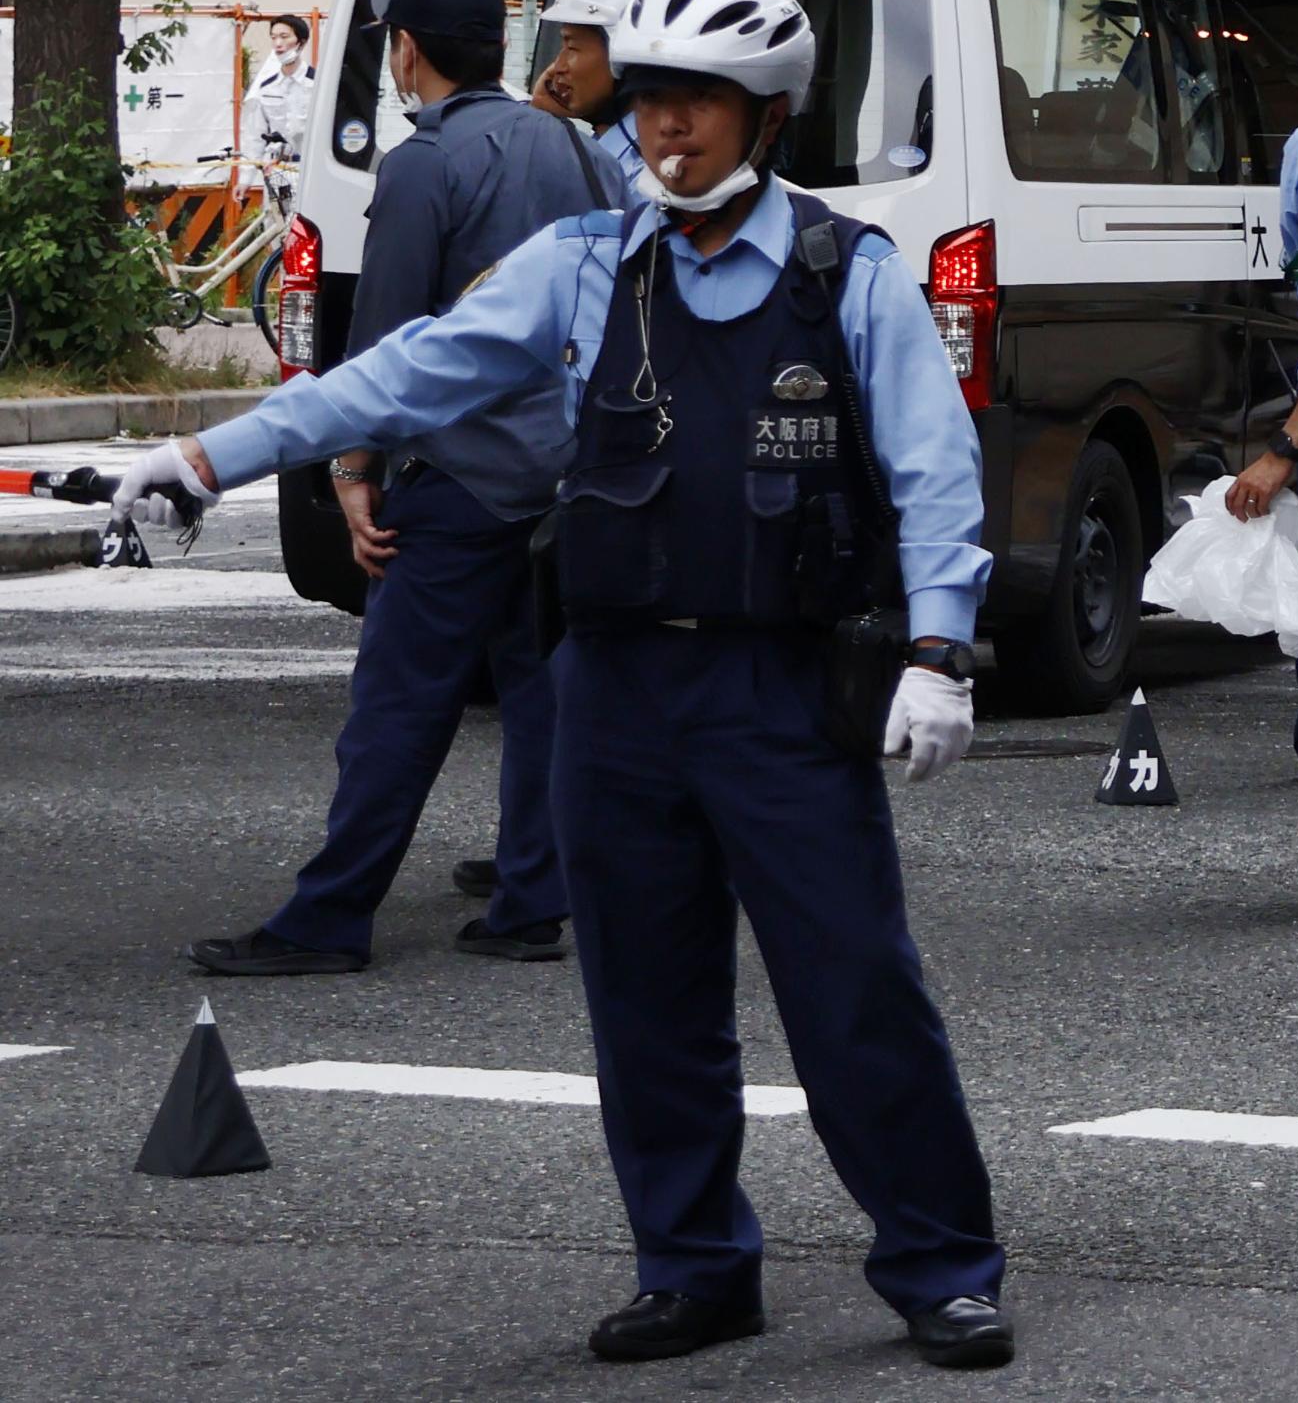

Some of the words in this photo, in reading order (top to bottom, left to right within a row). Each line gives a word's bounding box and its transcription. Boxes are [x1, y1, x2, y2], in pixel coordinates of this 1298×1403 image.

[146, 86, 184, 111] 第一
[756, 443, 838, 459] POLICE
[1129, 749, 1159, 793] カ
